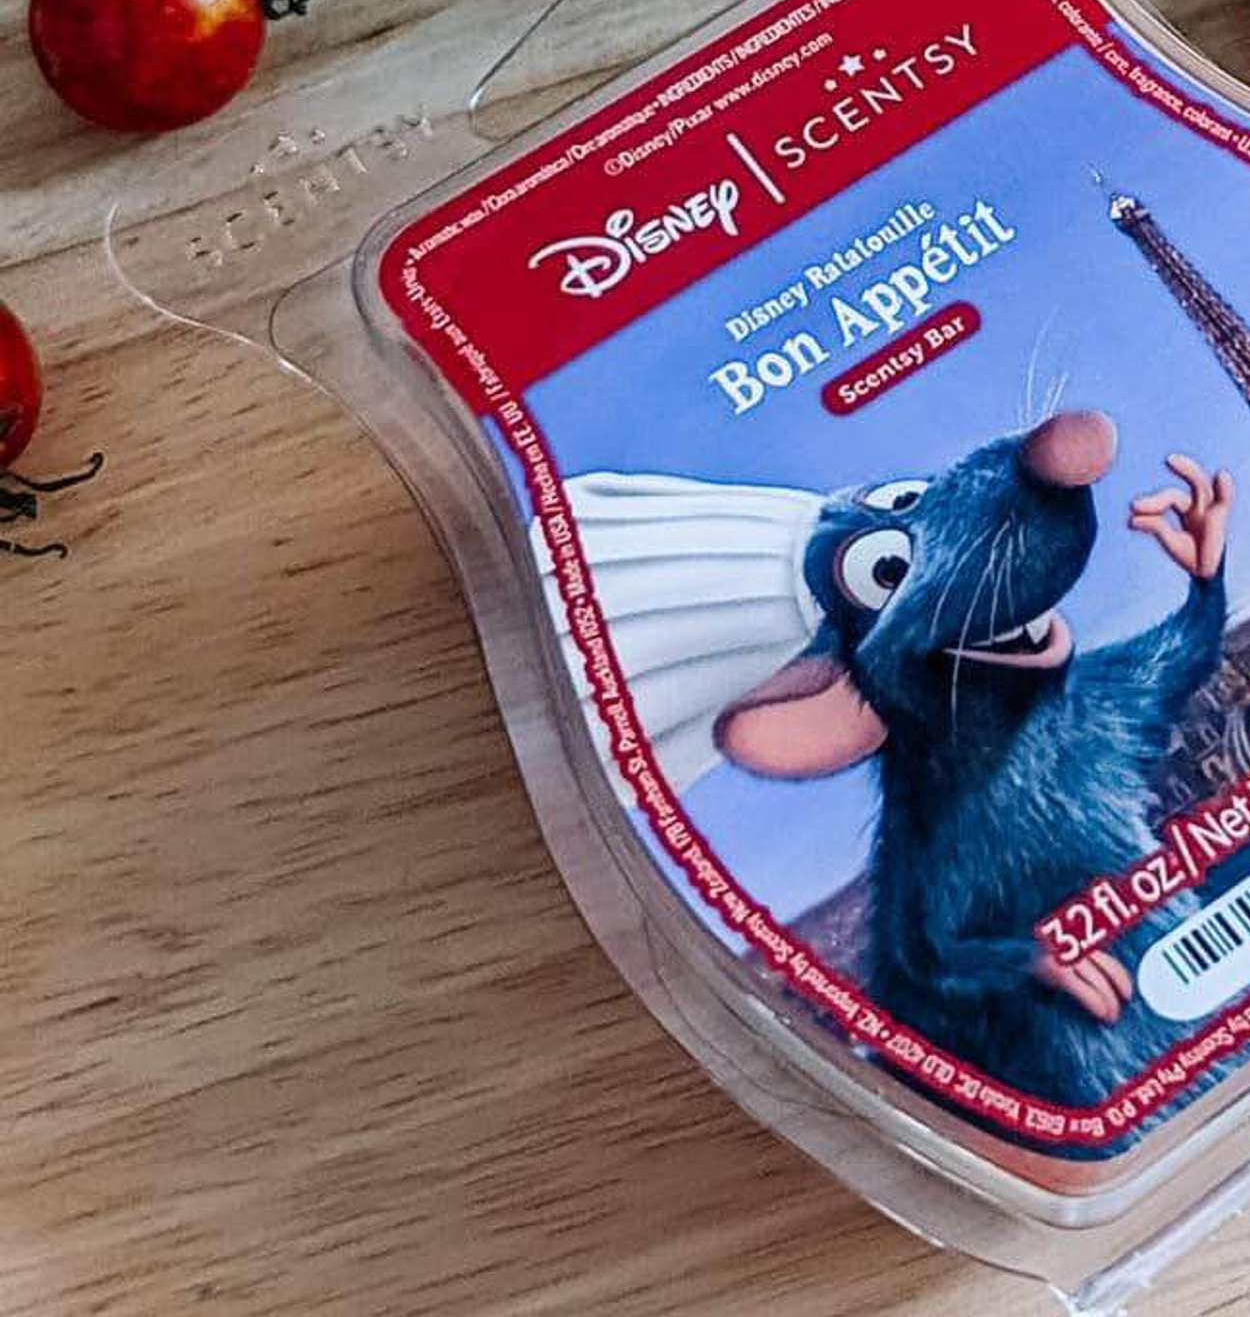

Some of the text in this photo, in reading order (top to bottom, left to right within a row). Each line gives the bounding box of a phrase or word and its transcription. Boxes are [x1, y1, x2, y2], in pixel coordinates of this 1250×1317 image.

[774, 23, 980, 170] SCENTSY
[708, 200, 1017, 416] Bon Appétit
[725, 200, 937, 343] Disney Ratatouille
[837, 315, 968, 405] Scentsy Bar
